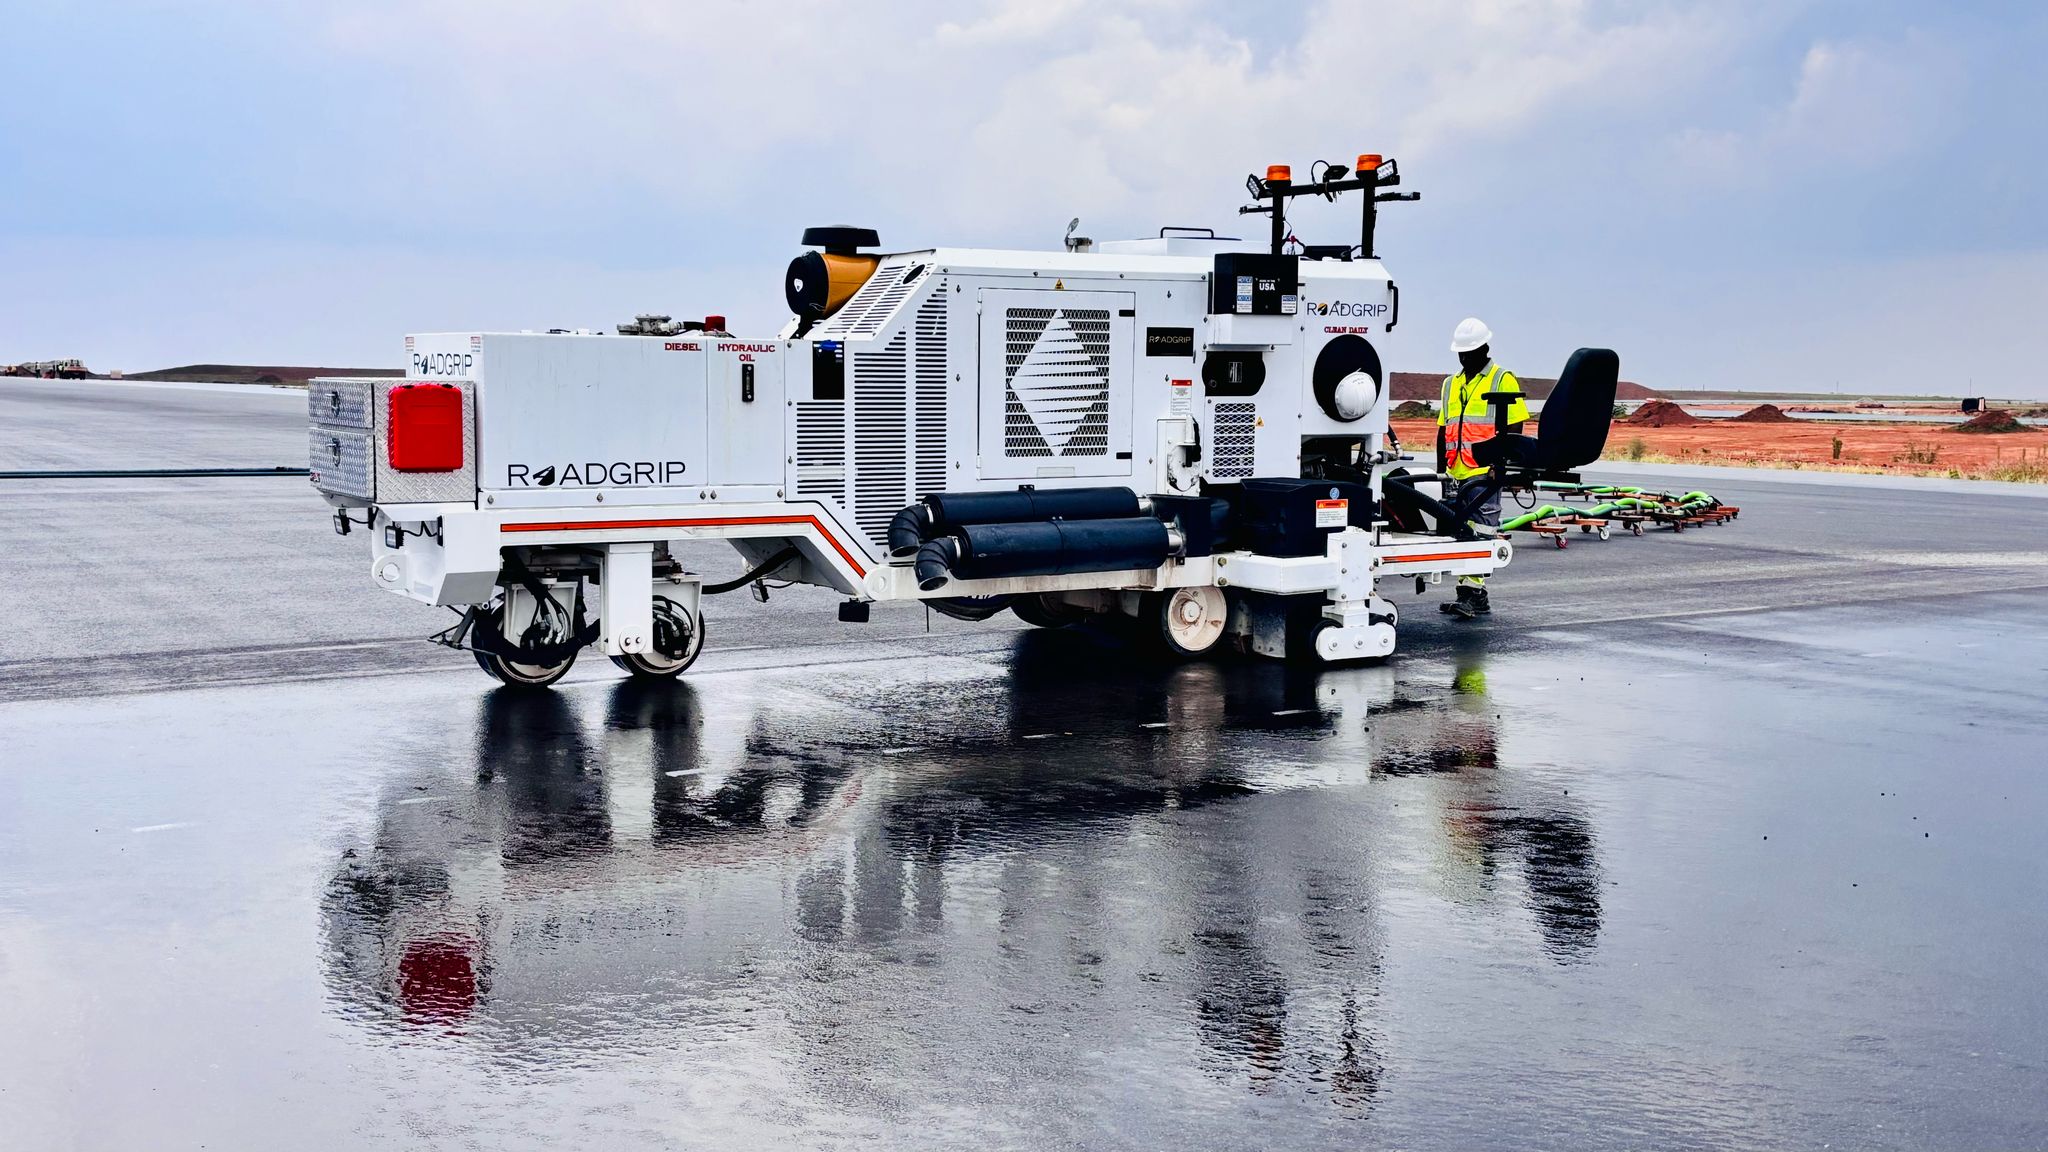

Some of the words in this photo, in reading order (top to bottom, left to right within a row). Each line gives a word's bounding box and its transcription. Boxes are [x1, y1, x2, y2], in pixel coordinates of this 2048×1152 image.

[1259, 283, 1276, 291] USA
[1307, 302, 1388, 317] ROADGRIP
[1348, 326, 1369, 334] DAILY
[1148, 335, 1192, 344] ROADGRIP
[664, 343, 702, 351] DIESEL
[717, 343, 776, 352] HYDRAULIC
[738, 354, 756, 362] OIL
[413, 353, 473, 376] ROADGRIP
[508, 461, 686, 487] ROADGRIP
